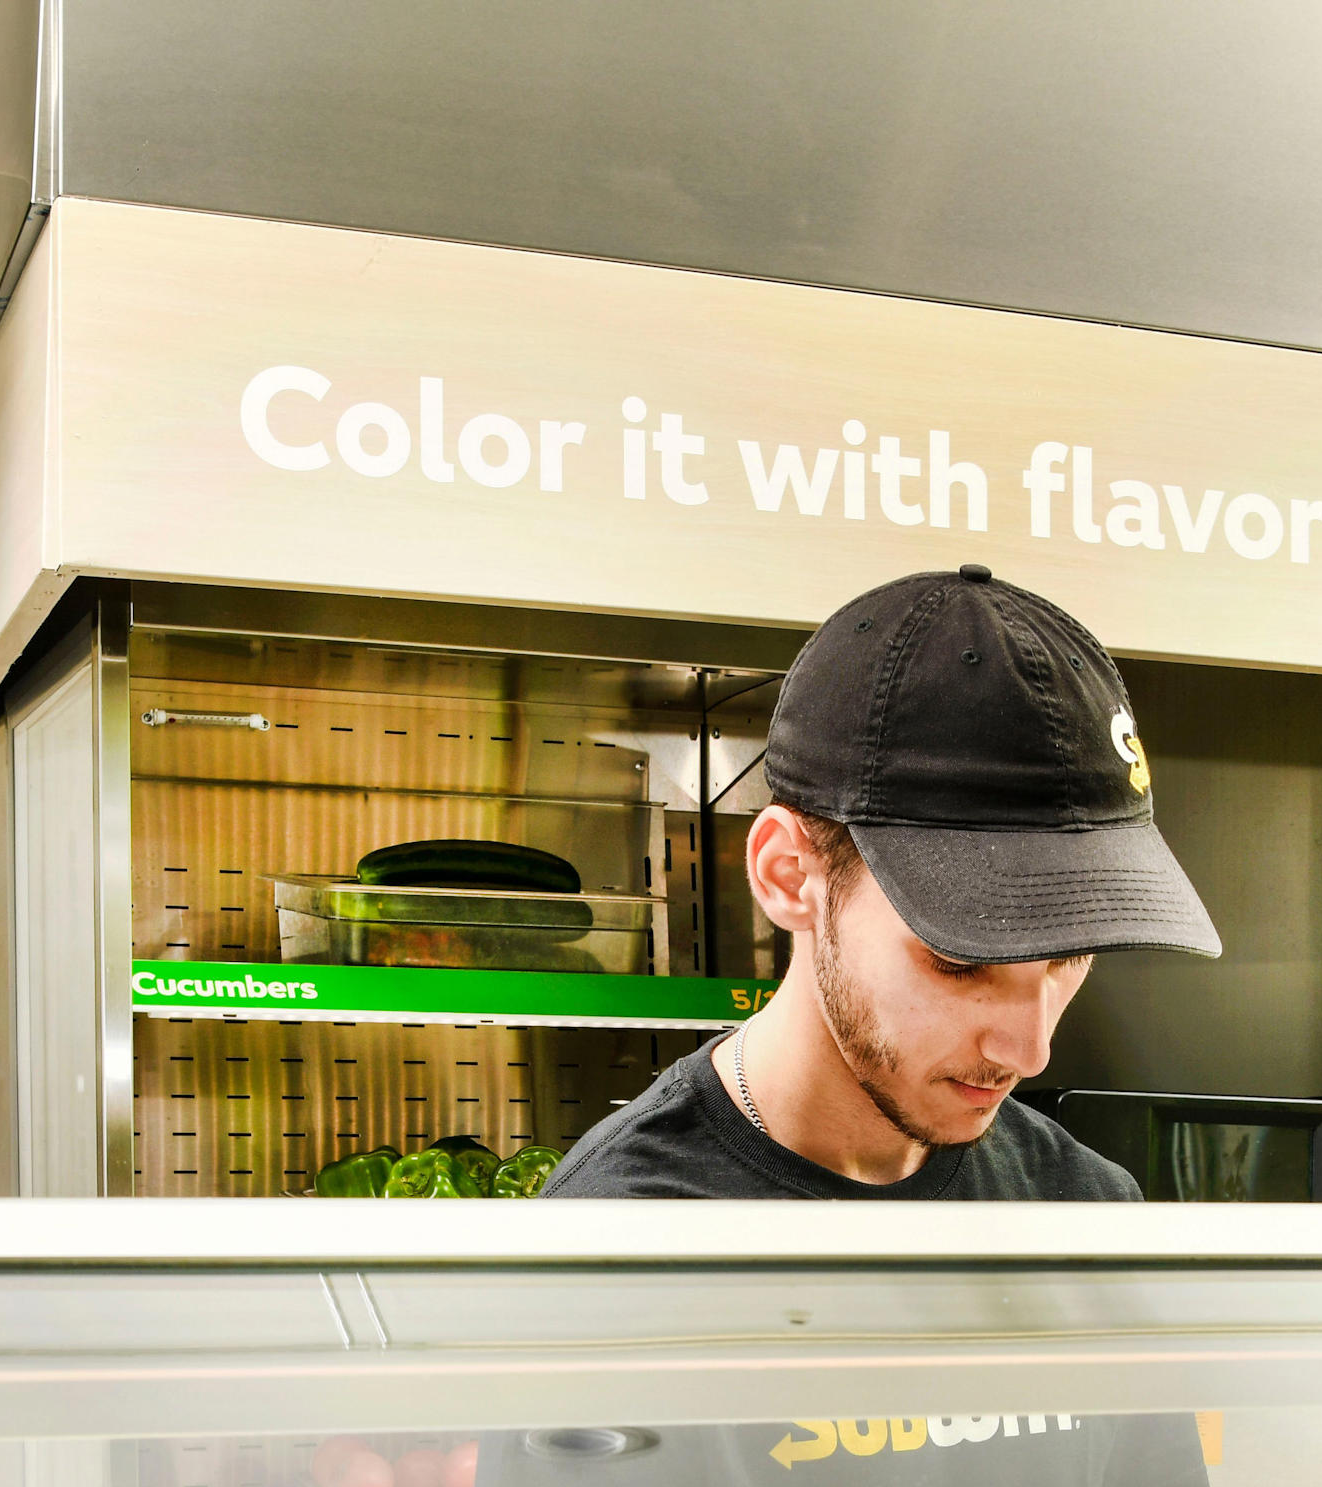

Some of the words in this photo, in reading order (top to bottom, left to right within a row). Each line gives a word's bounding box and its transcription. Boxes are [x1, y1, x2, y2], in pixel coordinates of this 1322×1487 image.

[240, 365, 586, 493] Color
[621, 395, 709, 506] it
[737, 419, 988, 533] with
[132, 971, 318, 999] Cucumbers
